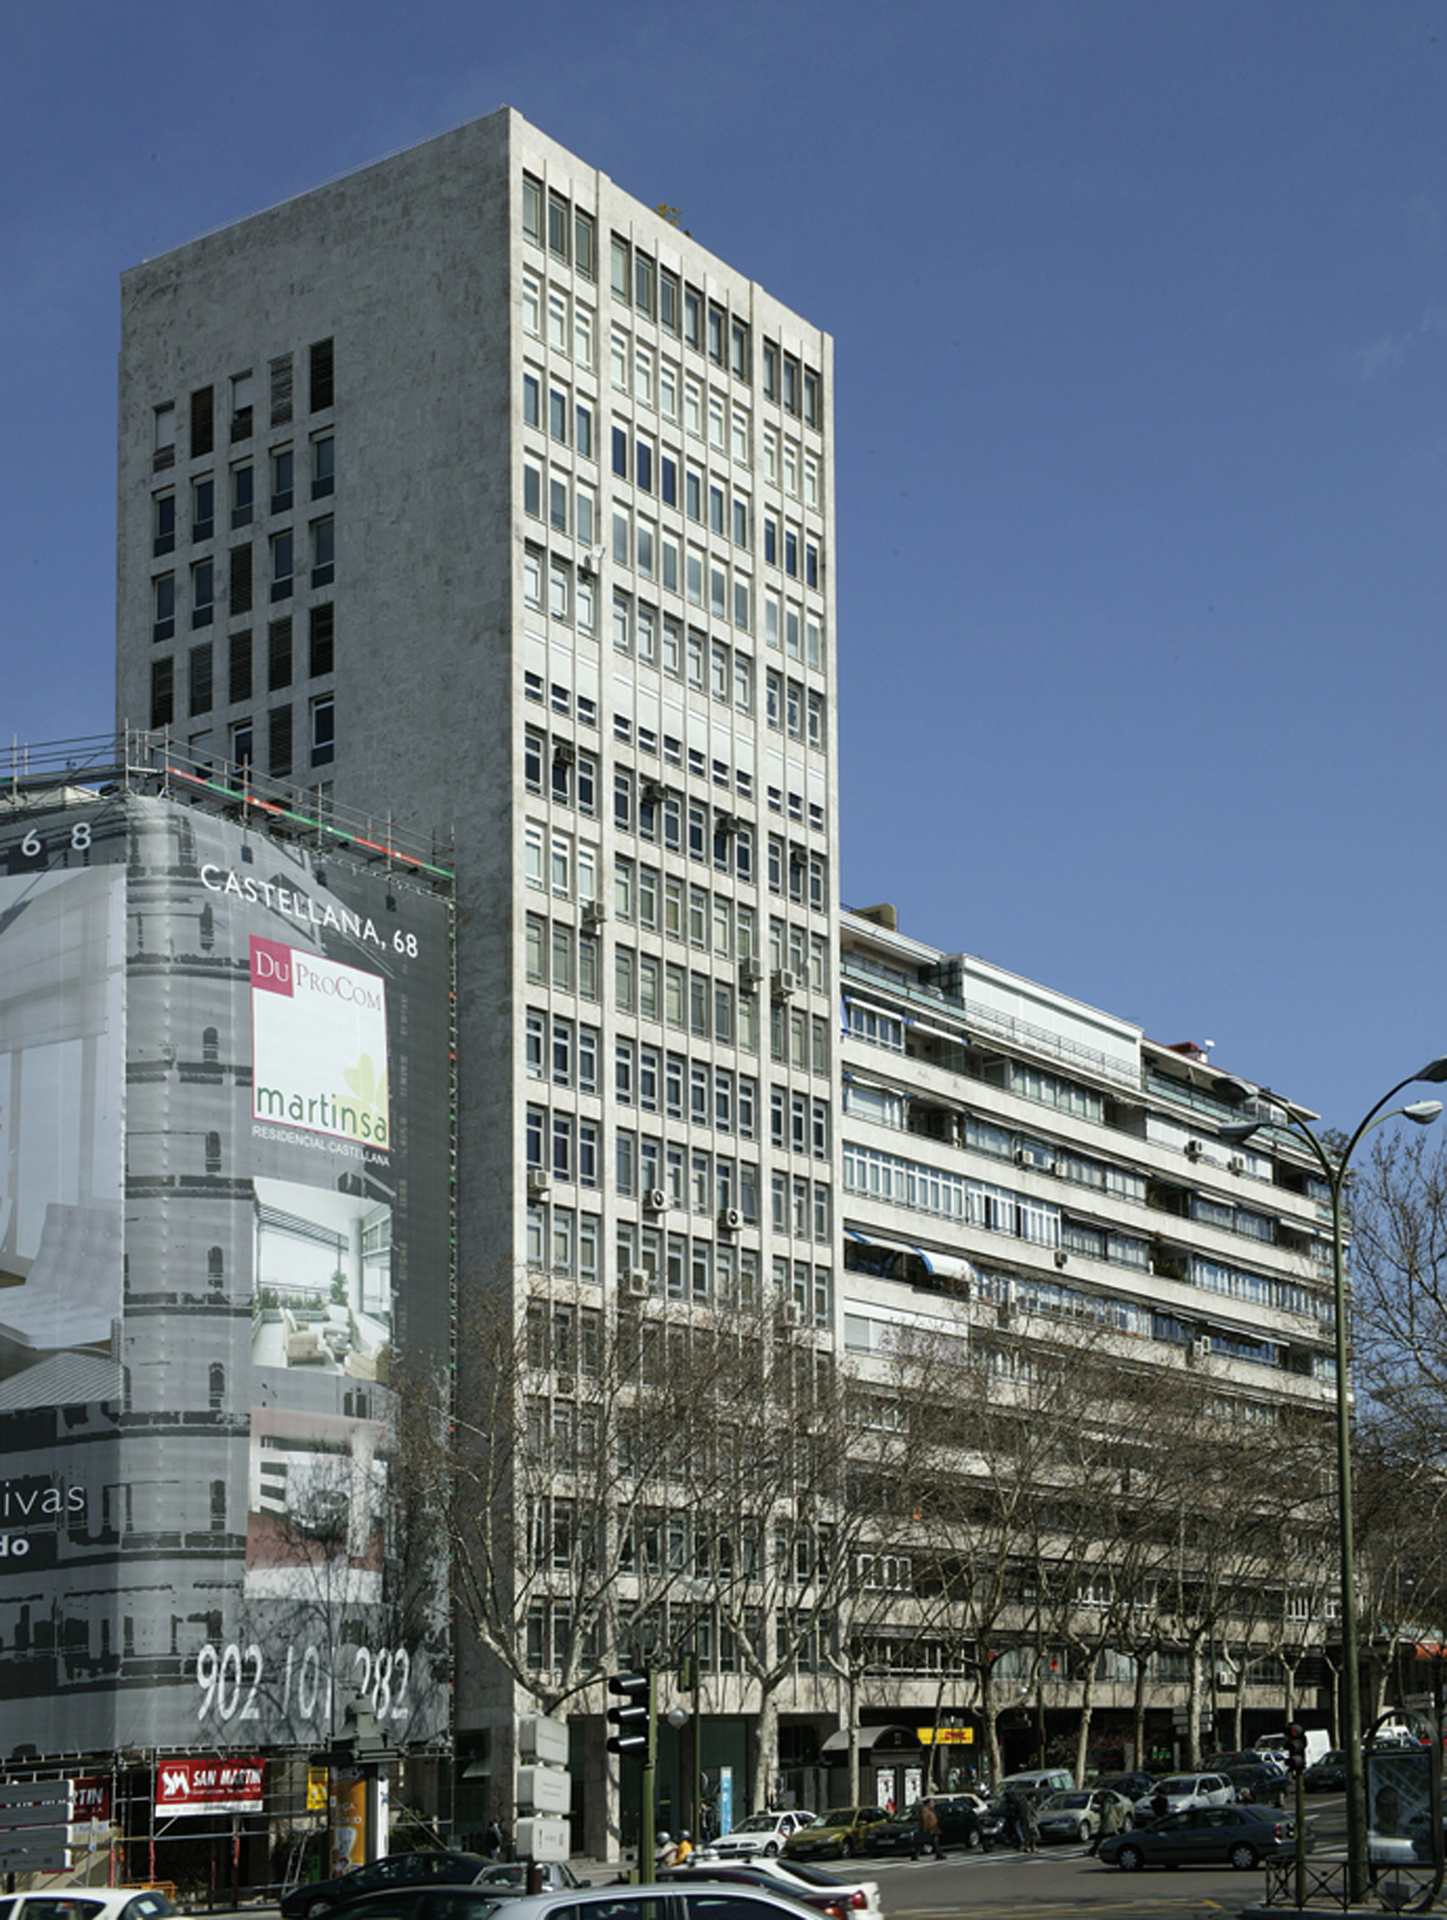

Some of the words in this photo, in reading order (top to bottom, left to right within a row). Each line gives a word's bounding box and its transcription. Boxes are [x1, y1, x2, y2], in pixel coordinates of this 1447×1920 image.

[201, 864, 387, 950] CASTELLANA,
[393, 930, 419, 959] 68
[257, 1086, 387, 1143] martinsa
[252, 1125, 327, 1151] RESIDENCIAL
[327, 1140, 391, 1168] CASTELLANA
[4, 1481, 84, 1517] ivas
[197, 1644, 263, 1721] 902
[281, 1645, 337, 1720] 101
[354, 1646, 410, 1720] 282
[192, 1770, 217, 1787] SAN
